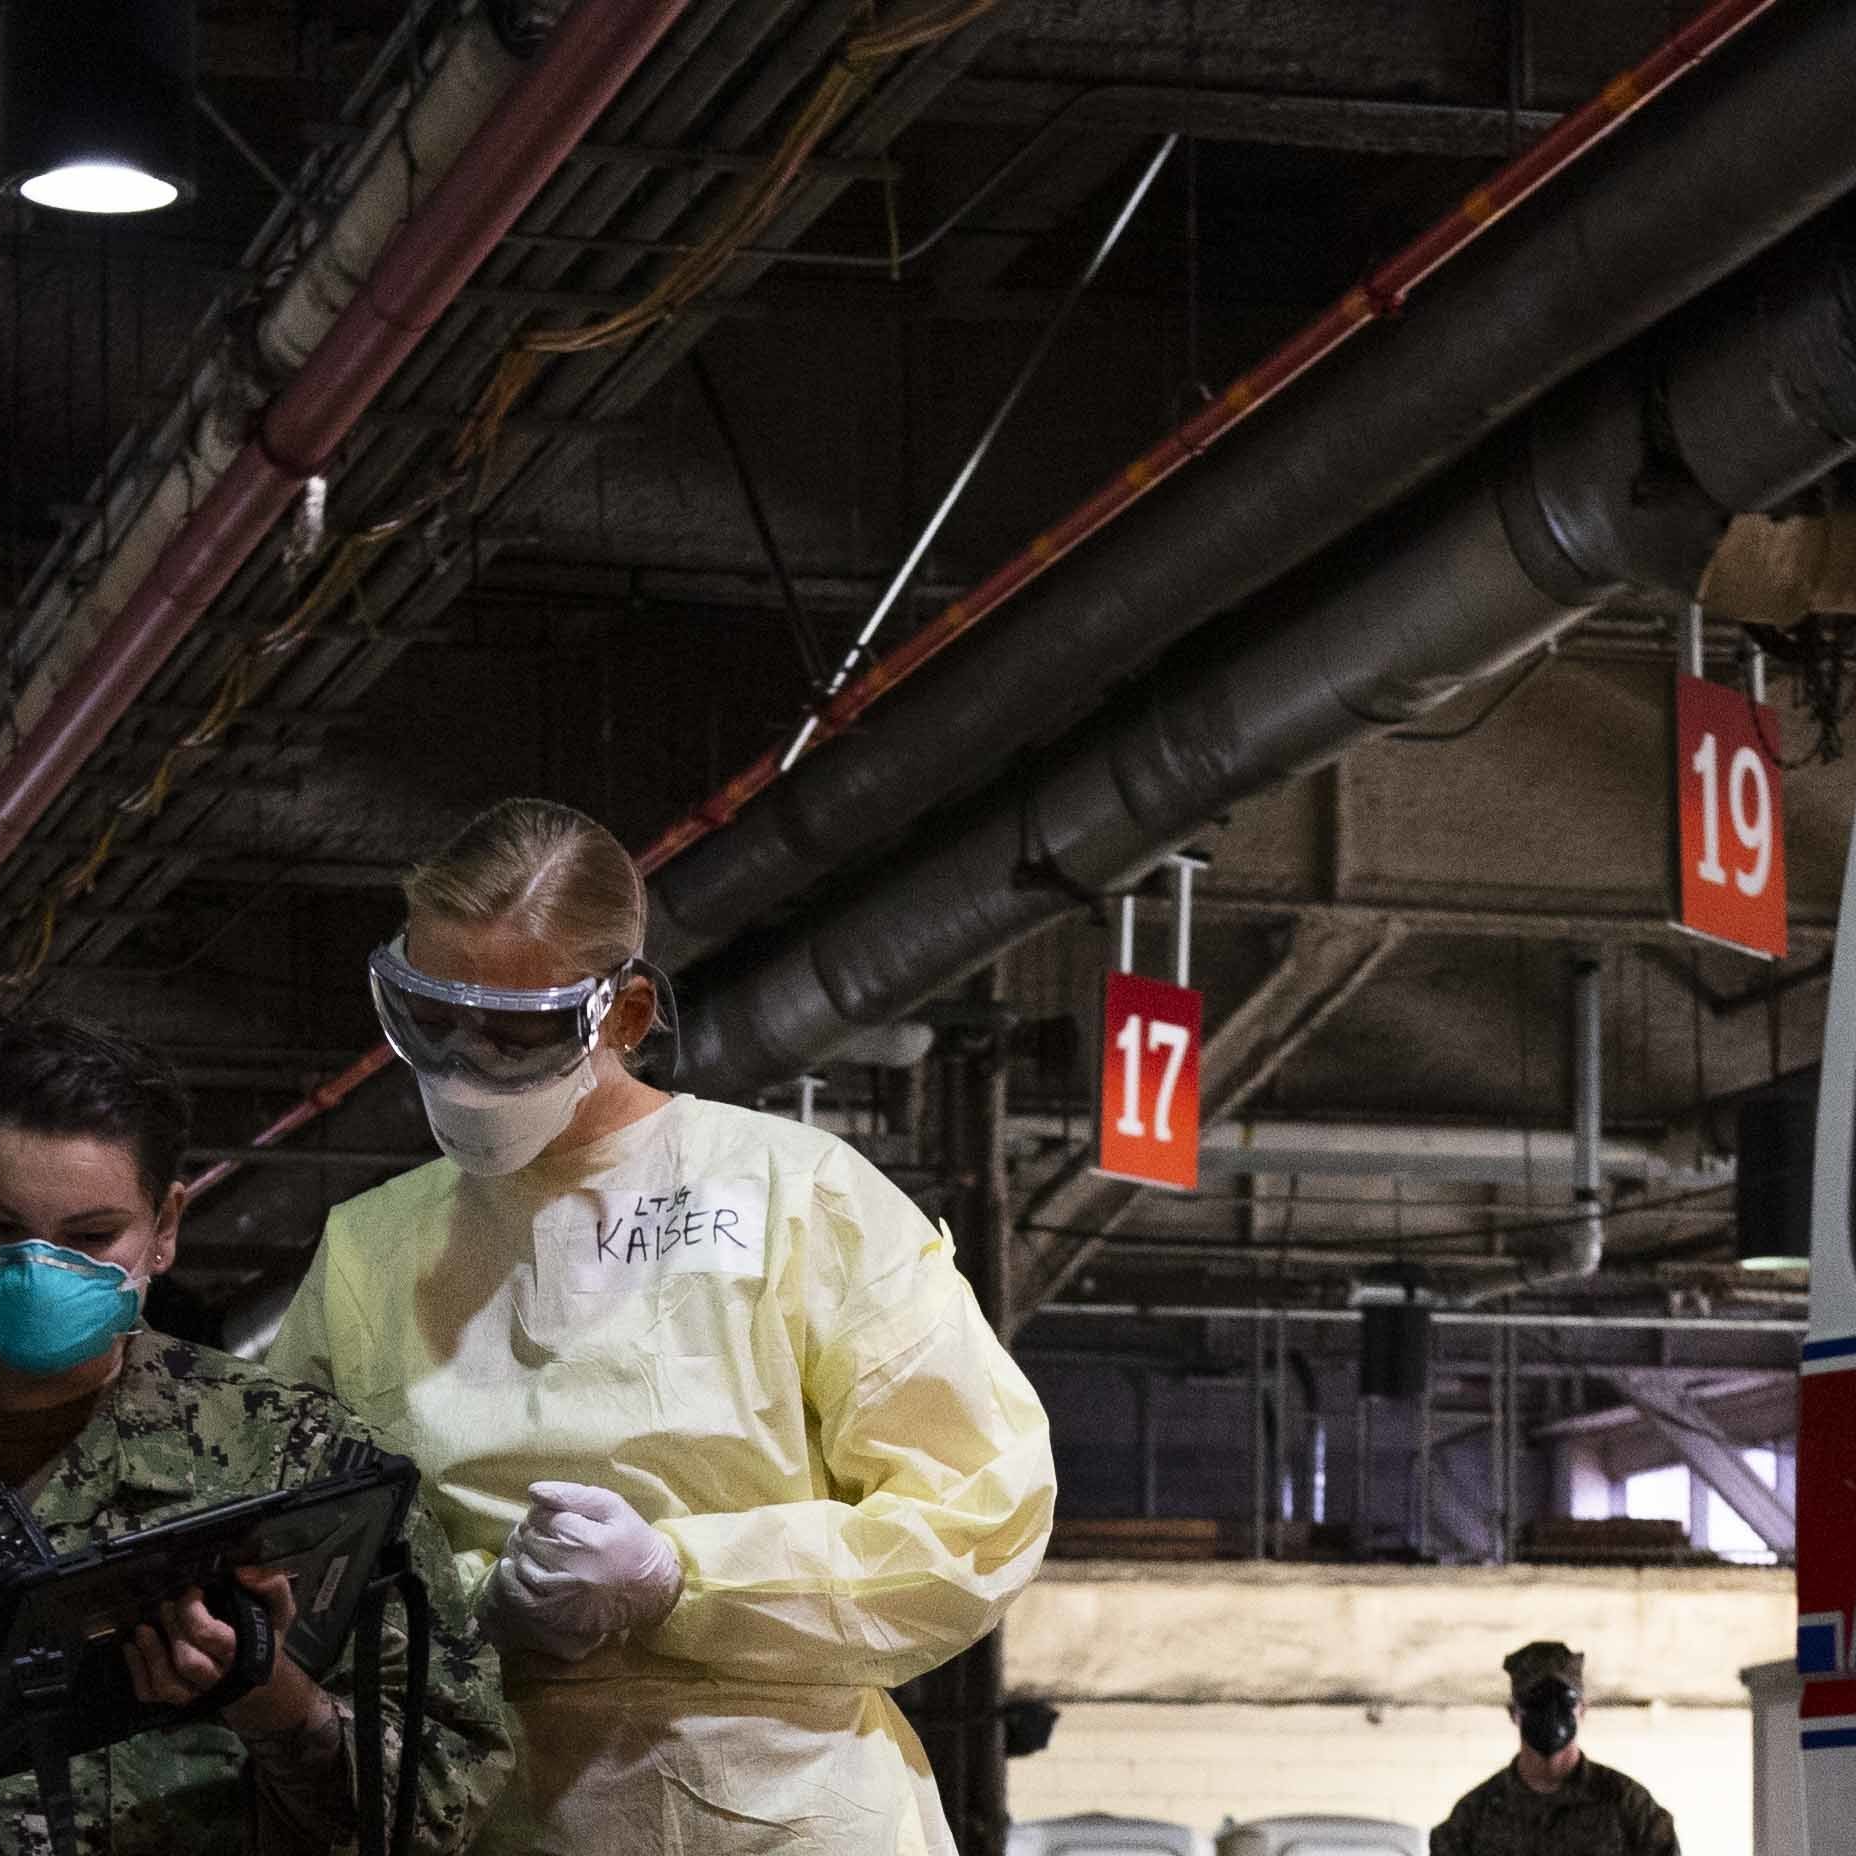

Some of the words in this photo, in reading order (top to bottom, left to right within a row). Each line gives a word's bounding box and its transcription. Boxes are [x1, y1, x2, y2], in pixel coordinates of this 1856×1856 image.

[1692, 732, 1773, 897] 19
[1116, 1014, 1190, 1142] 17
[596, 1208, 748, 1265] KAISER
